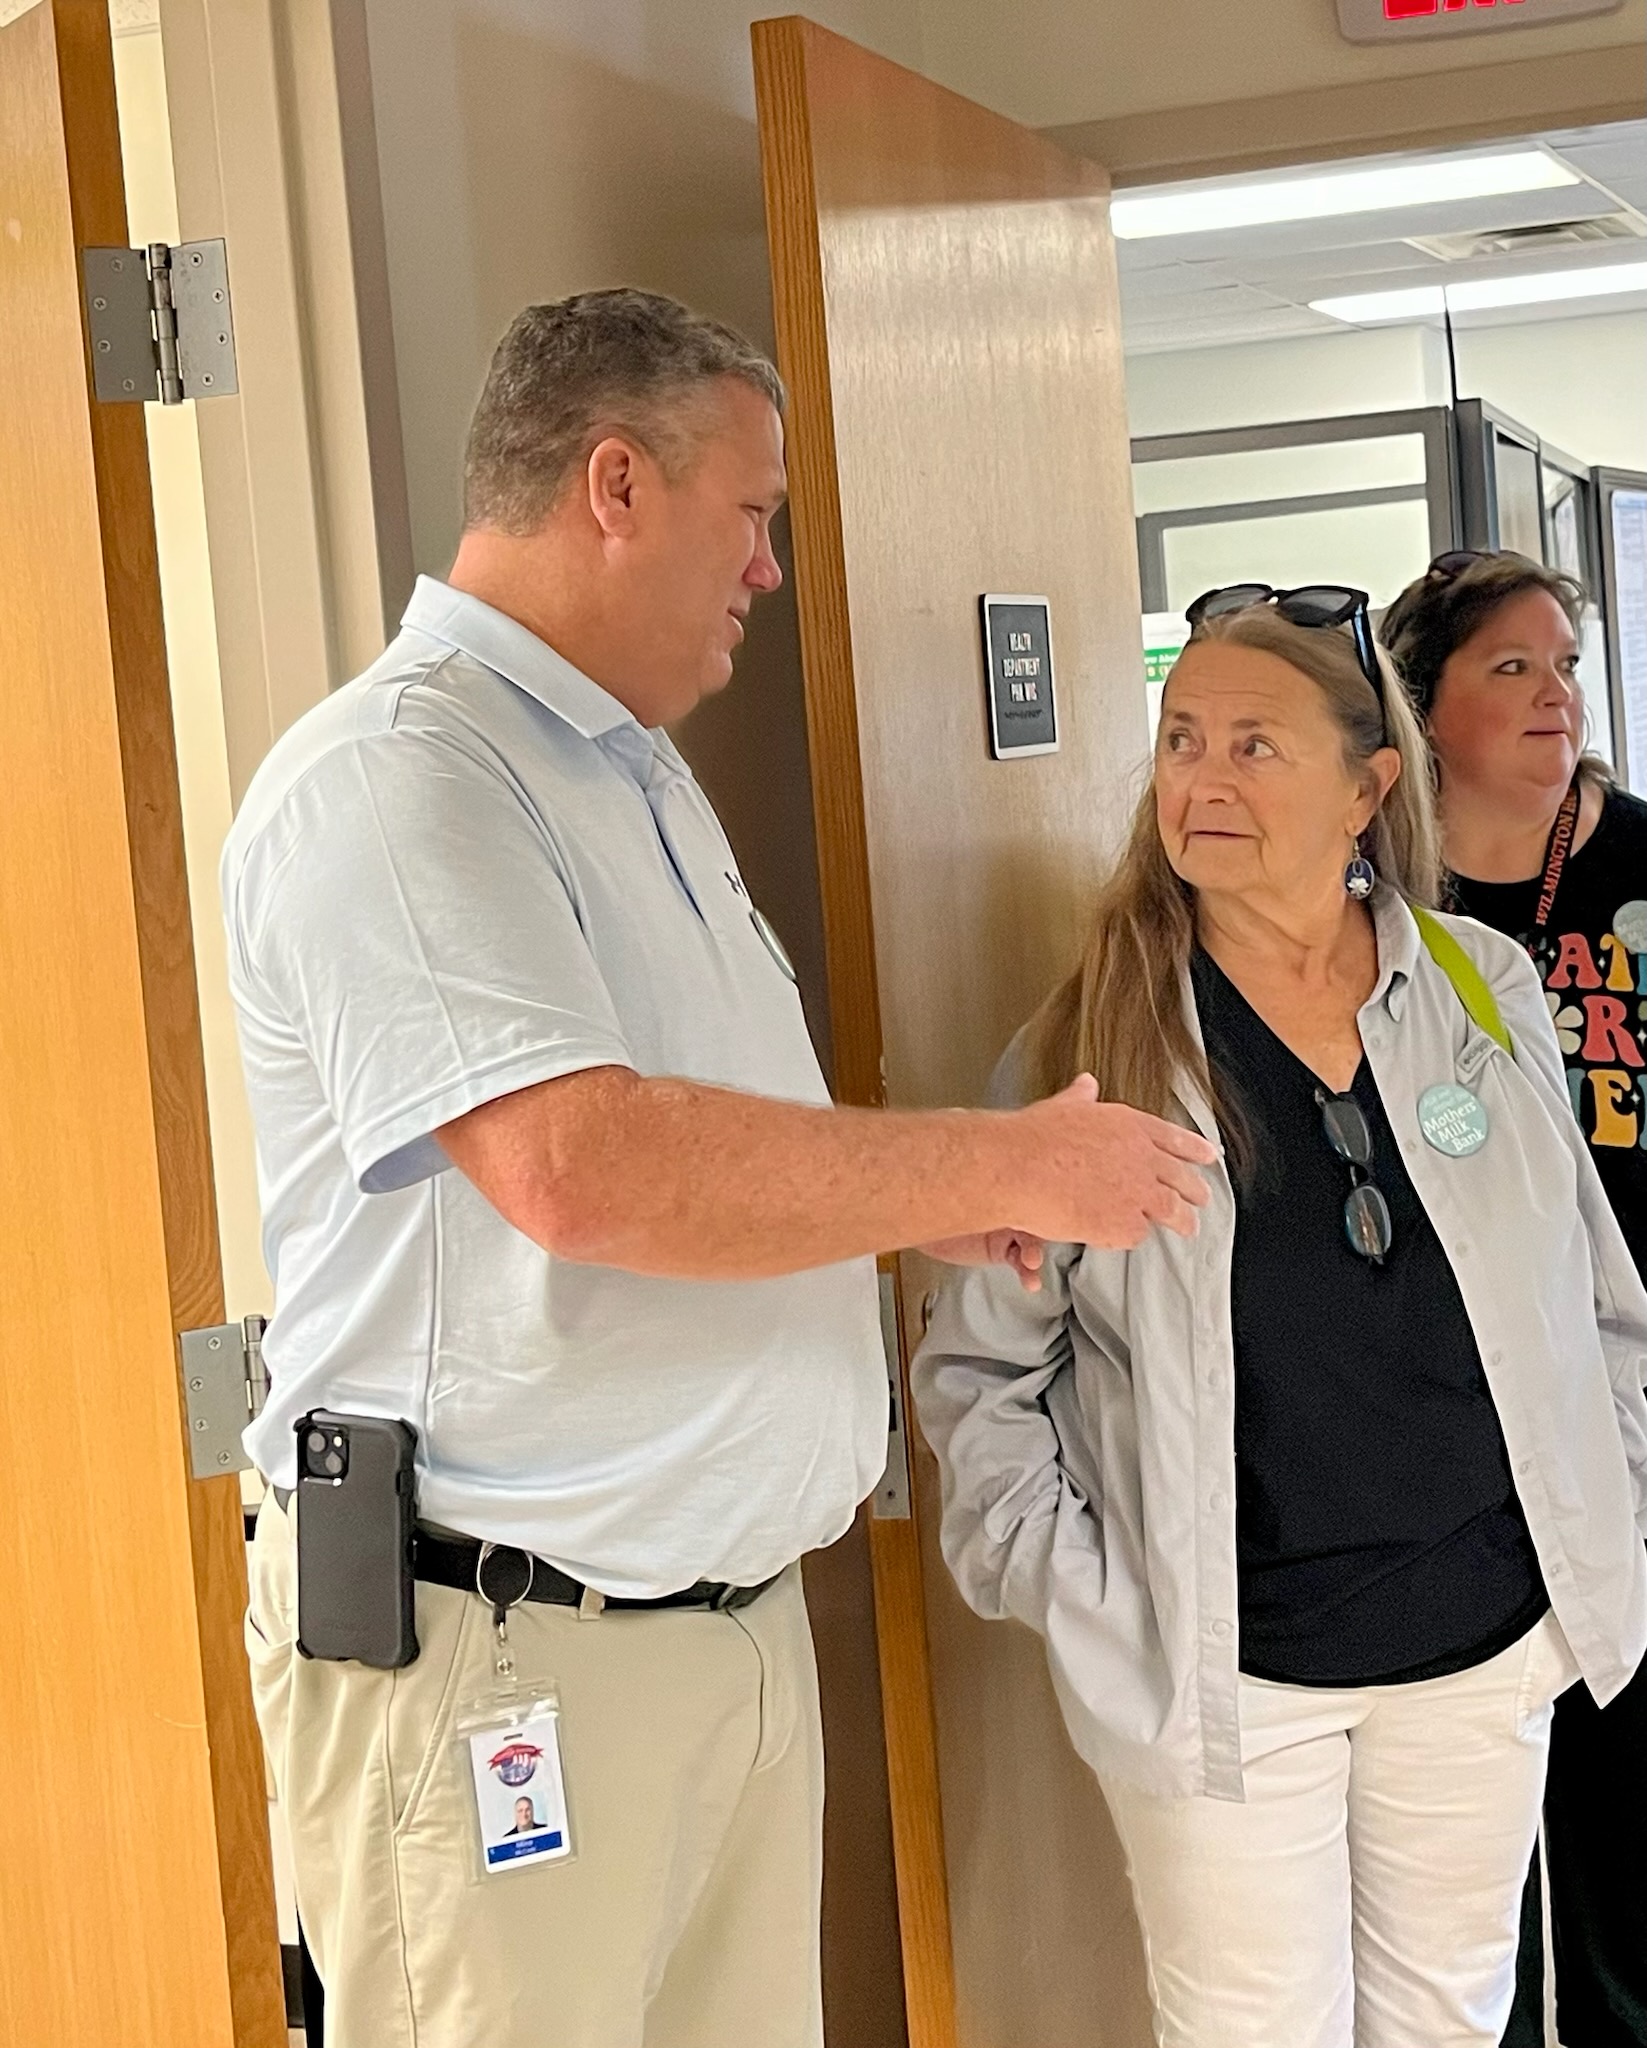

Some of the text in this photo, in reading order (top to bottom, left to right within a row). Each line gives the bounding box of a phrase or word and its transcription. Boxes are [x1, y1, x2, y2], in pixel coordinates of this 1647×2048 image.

[1535, 814, 1574, 926] WILMINGTON
[1438, 1119, 1471, 1143] Milk
[1451, 1127, 1486, 1152] Bank
